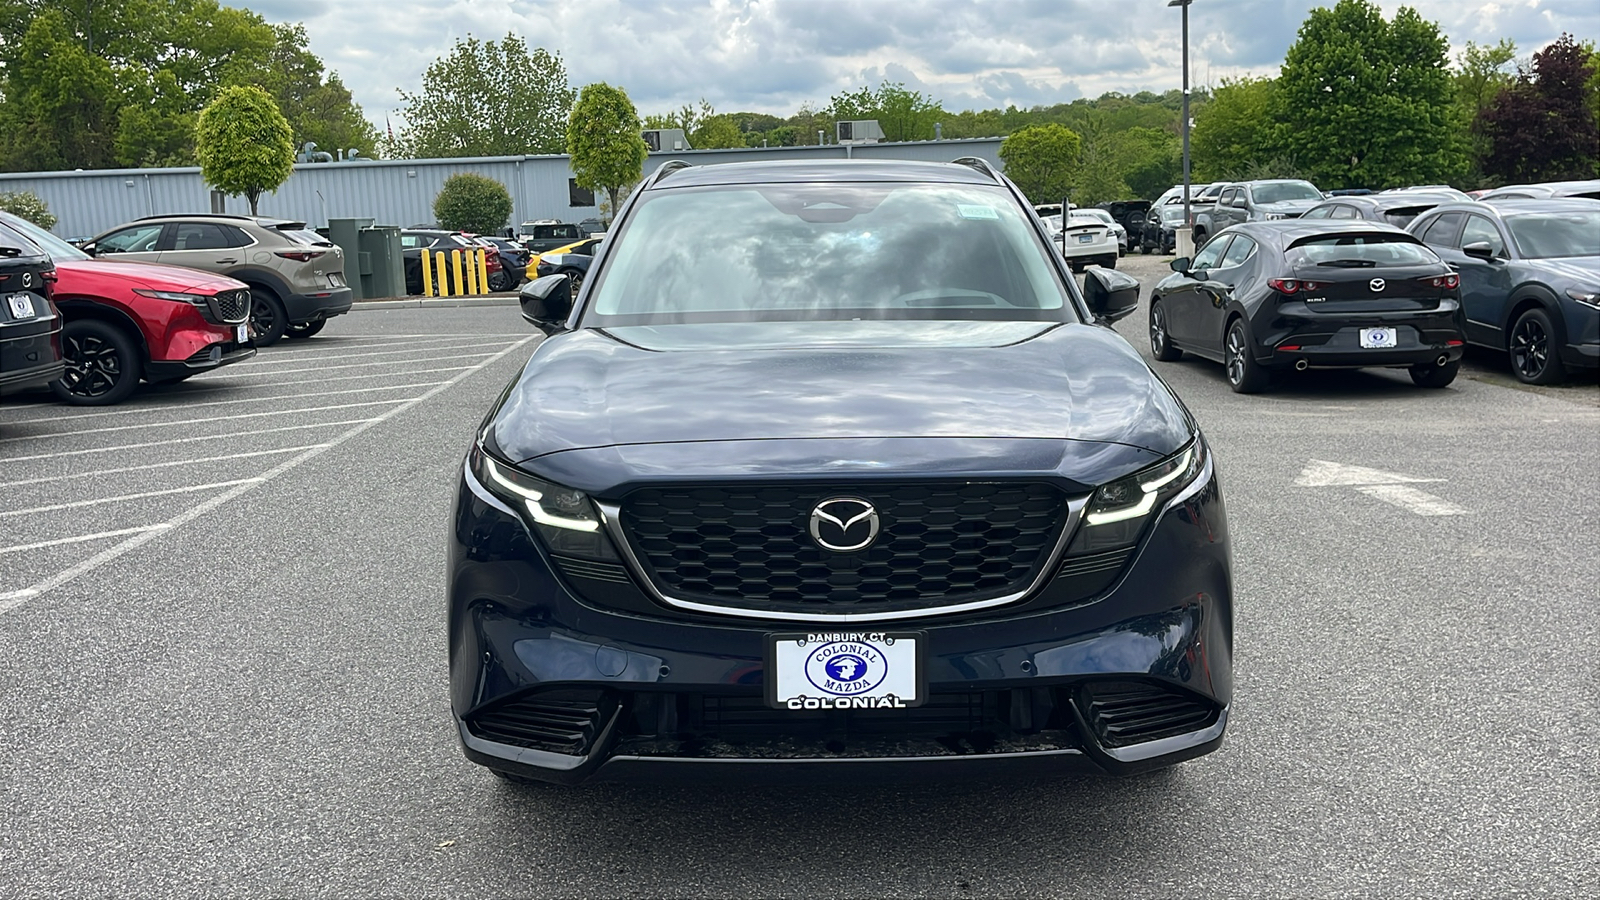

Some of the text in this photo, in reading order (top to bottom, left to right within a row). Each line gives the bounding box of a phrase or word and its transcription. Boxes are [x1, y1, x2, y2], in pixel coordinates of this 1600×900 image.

[807, 632, 886, 642] DANBURY, CT
[816, 644, 877, 664] COLONIAL
[824, 679, 871, 692] MAZDA
[787, 697, 906, 709] COLONIAL
